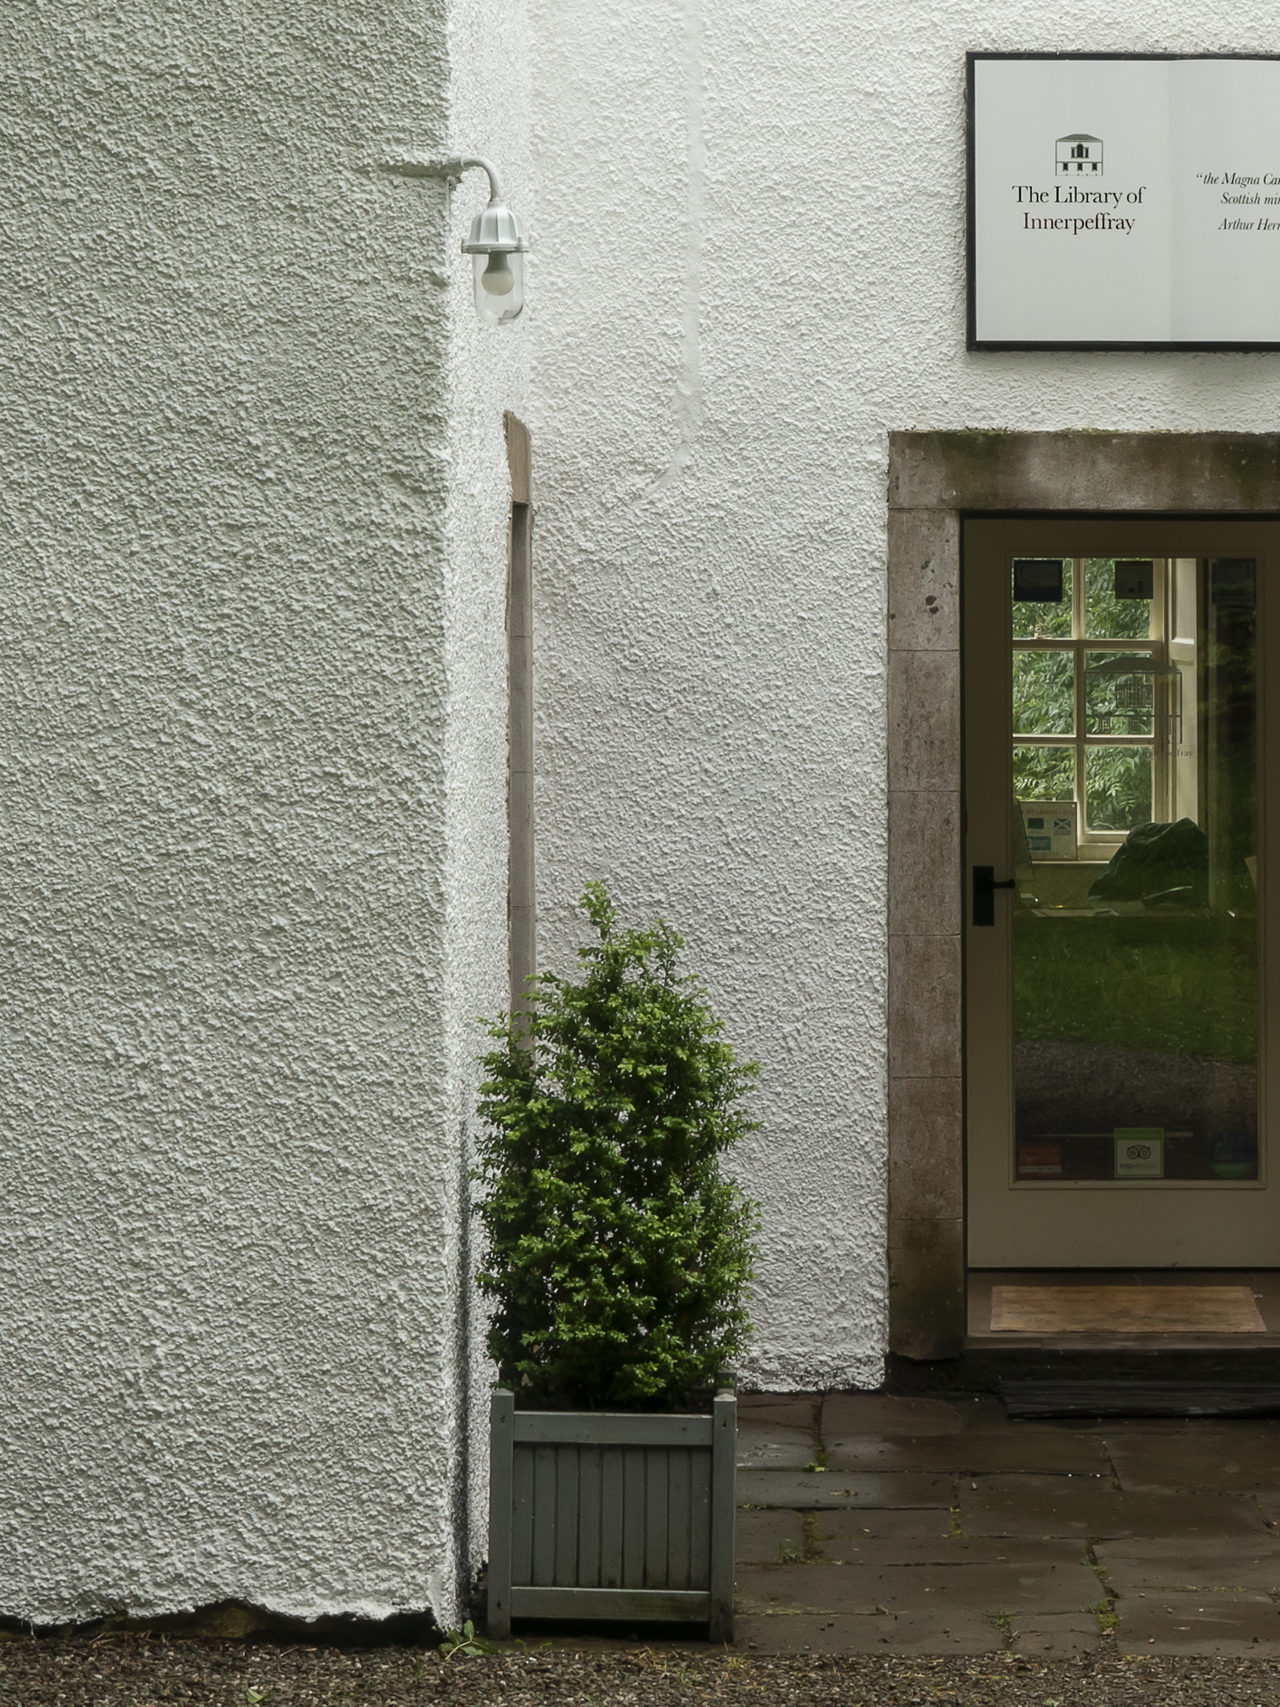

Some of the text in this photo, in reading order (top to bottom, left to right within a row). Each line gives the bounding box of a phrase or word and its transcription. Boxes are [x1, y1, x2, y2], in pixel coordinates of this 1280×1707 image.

[1220, 173, 1260, 189] Magna
[1011, 185, 1147, 209] The Library of
[1220, 192, 1261, 205] Scottish
[1023, 212, 1136, 236] Innerpeffray
[1217, 217, 1255, 231] Arthur
